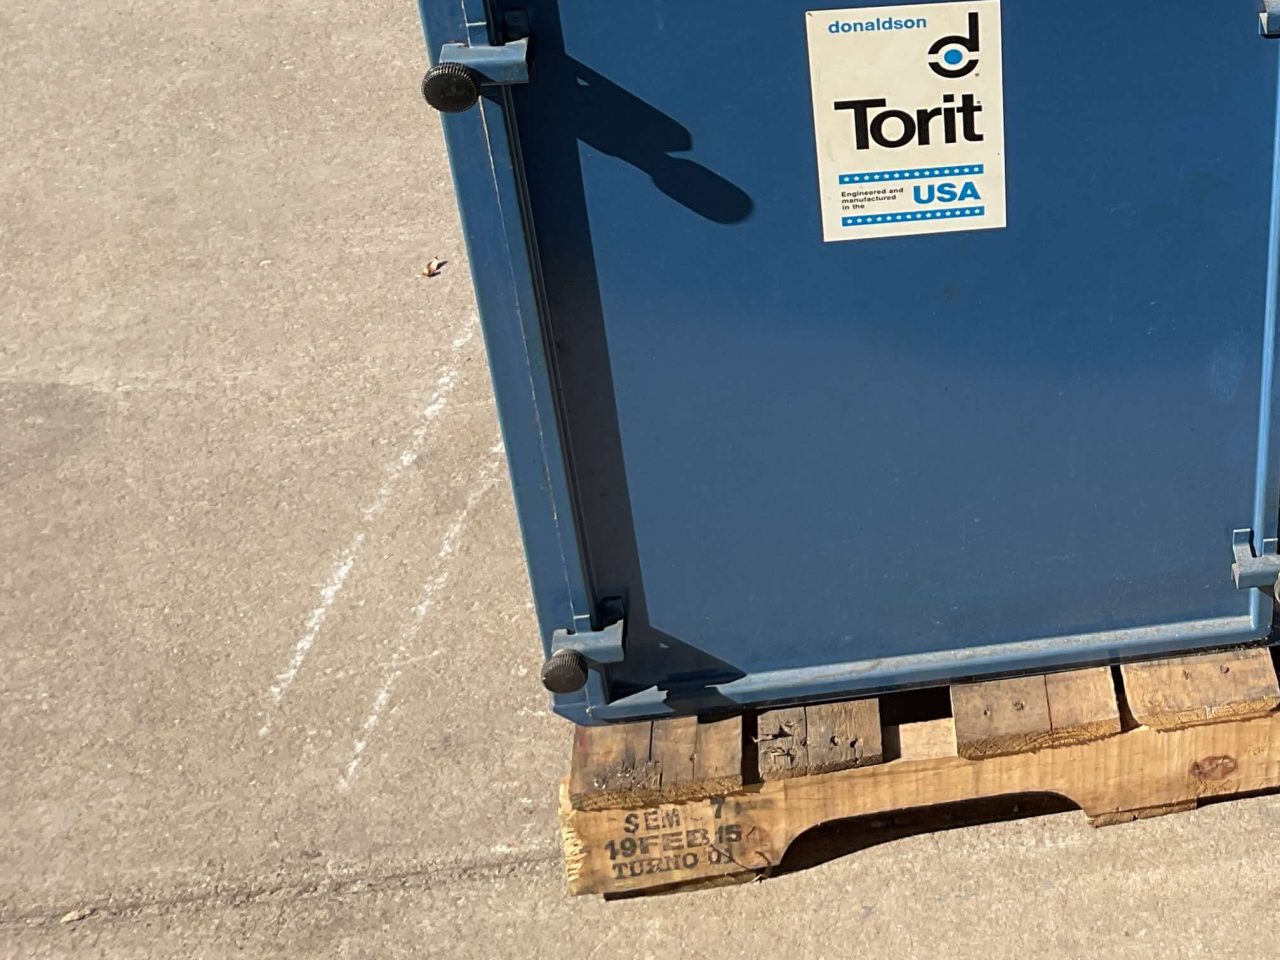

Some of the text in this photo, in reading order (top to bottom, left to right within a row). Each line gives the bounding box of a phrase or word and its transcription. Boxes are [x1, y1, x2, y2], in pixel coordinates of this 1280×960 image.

[828, 16, 927, 33] donaldson
[834, 94, 984, 150] Torit
[841, 187, 904, 198] Engineered and
[841, 194, 897, 204] manufactured
[913, 181, 981, 205] USA
[624, 808, 680, 833] SEM
